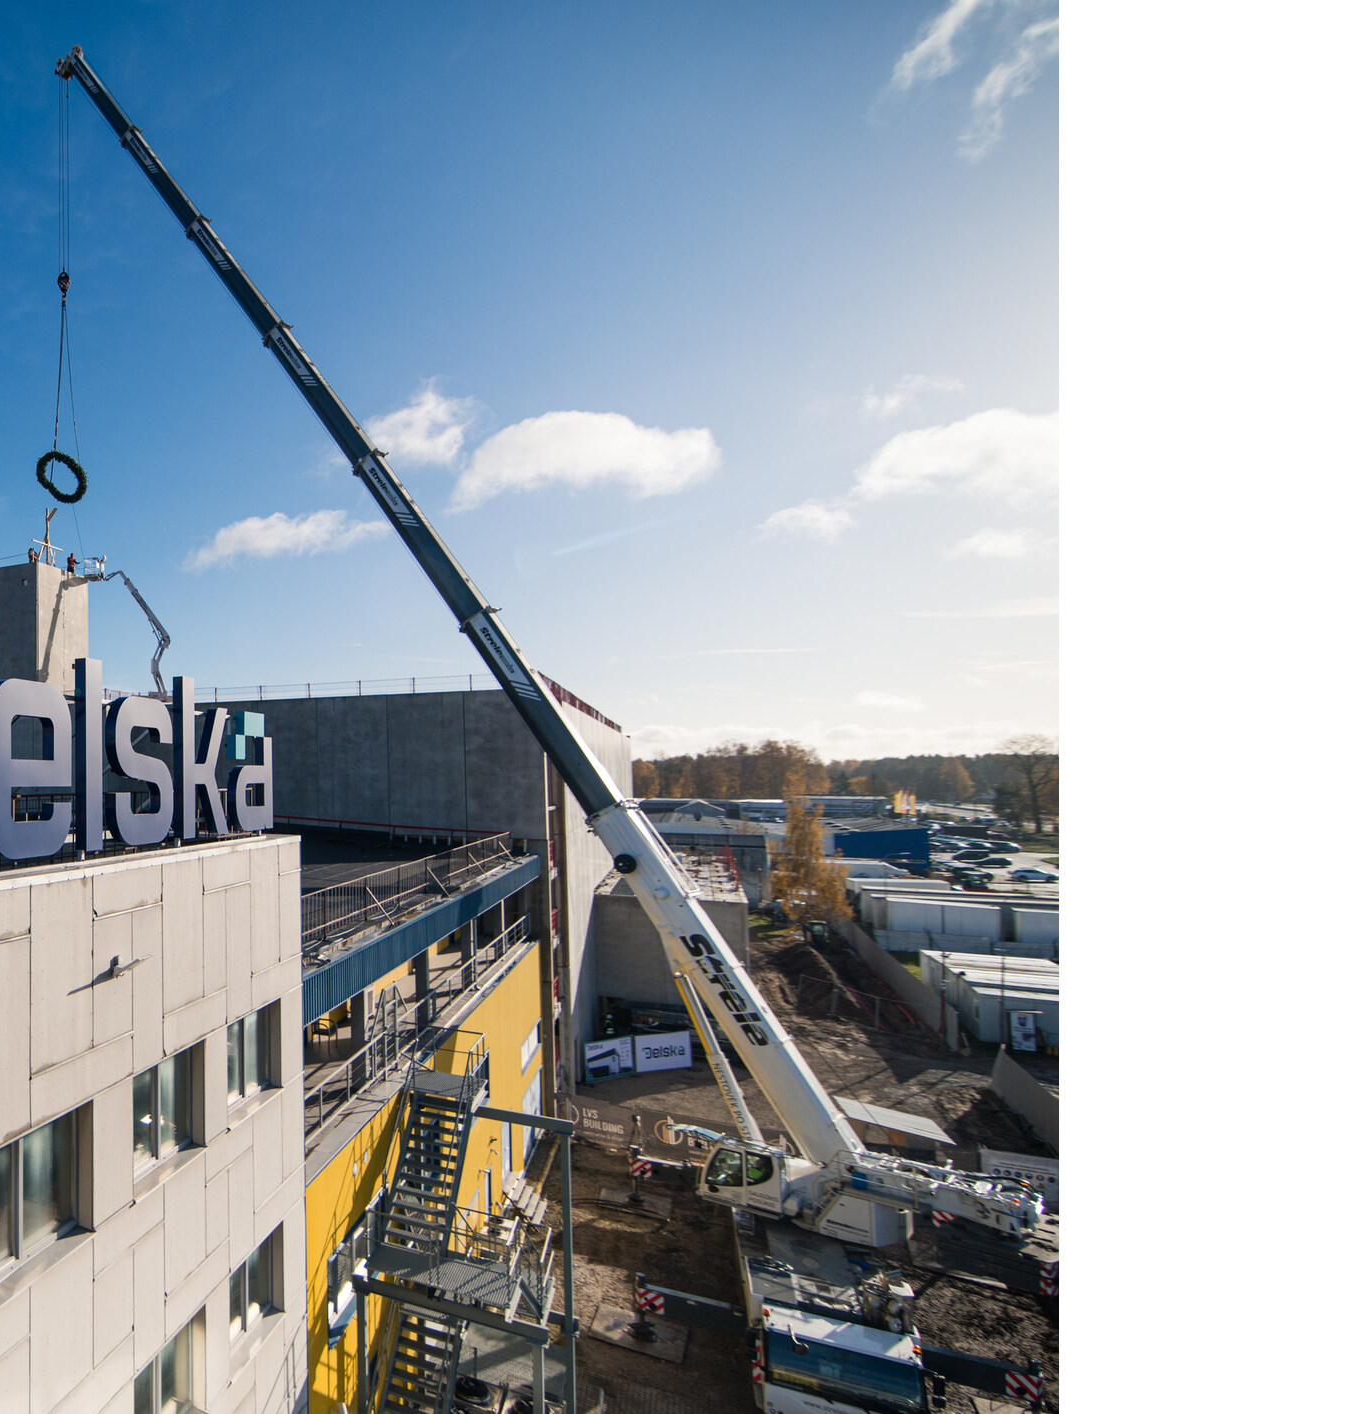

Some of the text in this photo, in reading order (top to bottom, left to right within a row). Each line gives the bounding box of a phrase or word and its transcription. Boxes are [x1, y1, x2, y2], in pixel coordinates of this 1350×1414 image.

[642, 1044, 685, 1059] Delska
[582, 1107, 598, 1119] LVS
[583, 1118, 624, 1134] BUILDING
